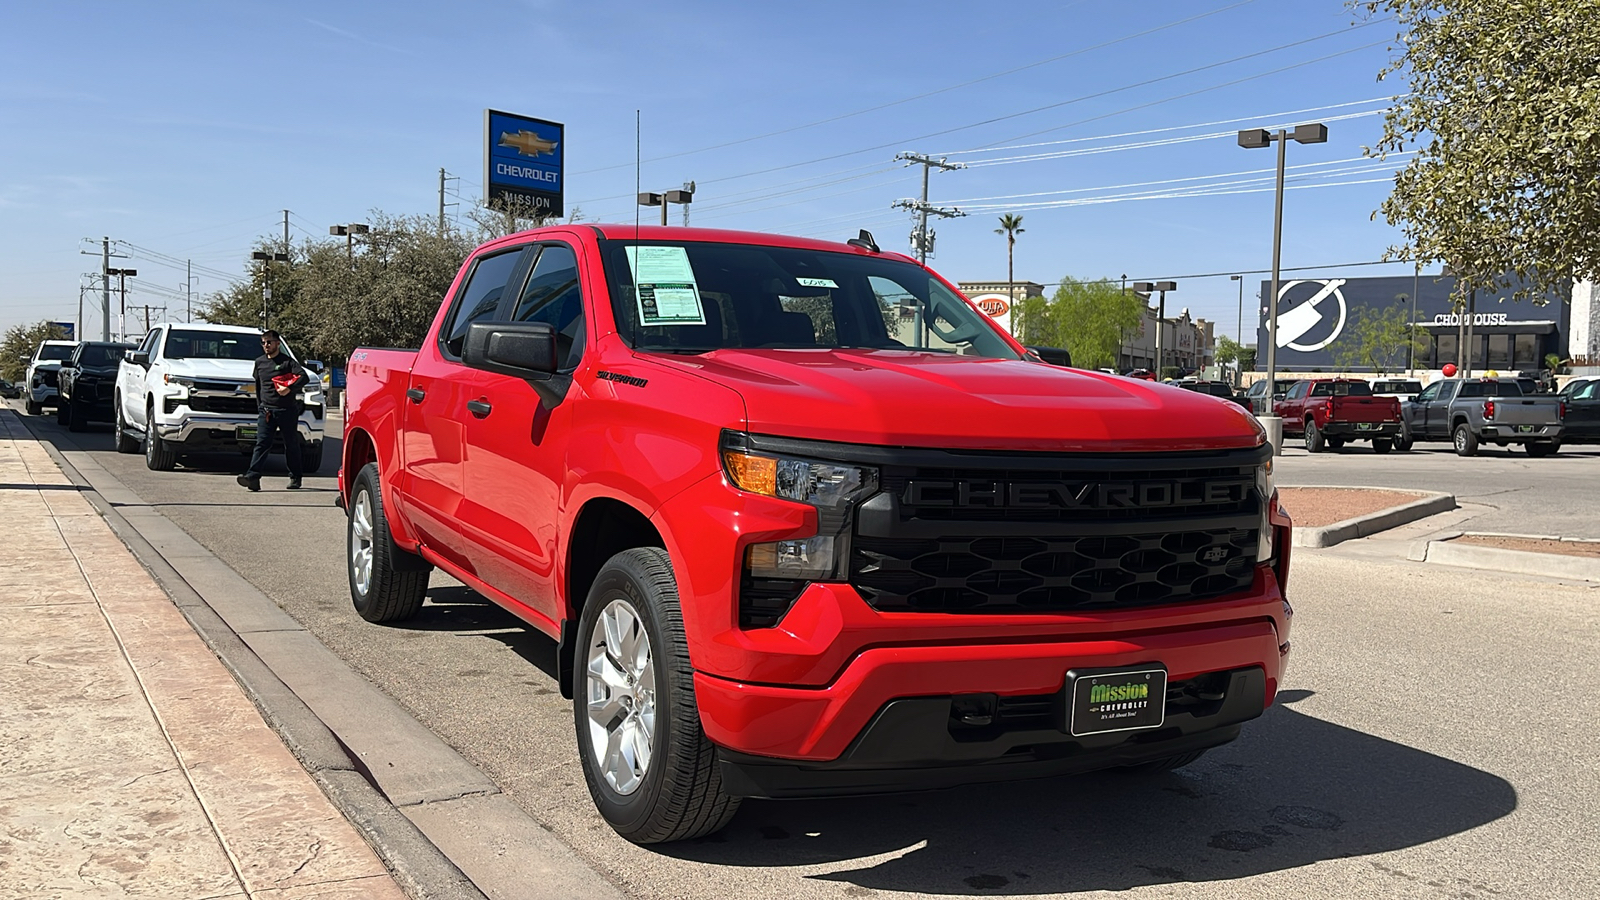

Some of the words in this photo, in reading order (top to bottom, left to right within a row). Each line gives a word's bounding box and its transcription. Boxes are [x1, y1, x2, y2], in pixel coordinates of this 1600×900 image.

[497, 163, 558, 183] CHEVROLET
[504, 190, 550, 208] MISSION
[981, 301, 1004, 310] ULTA
[595, 370, 648, 388] SILVERADO
[902, 480, 1255, 508] CHEVROLET
[1100, 700, 1147, 712] CHEVROLET
